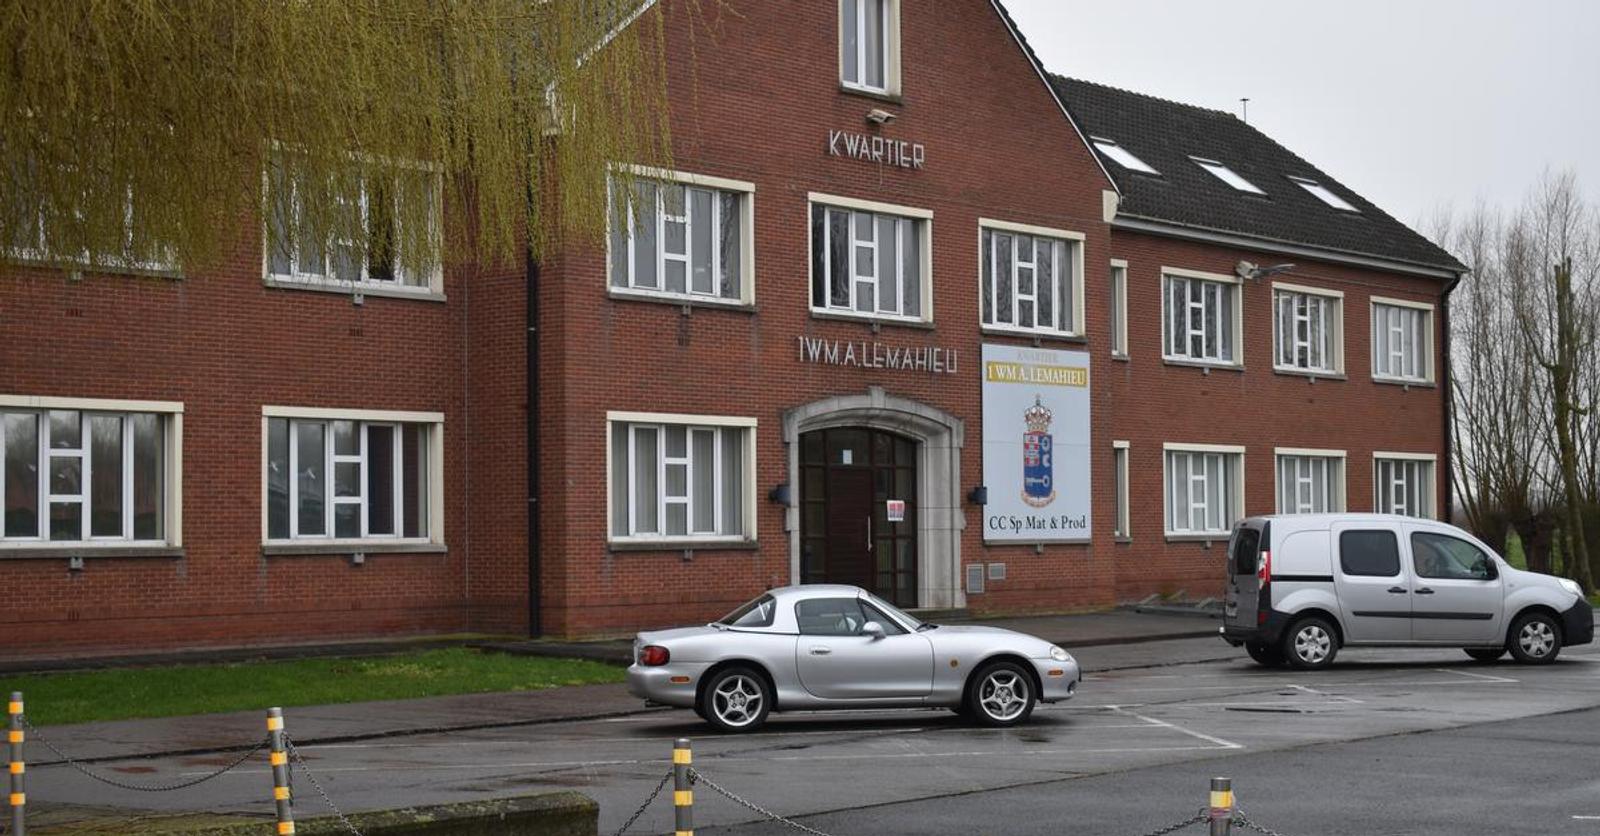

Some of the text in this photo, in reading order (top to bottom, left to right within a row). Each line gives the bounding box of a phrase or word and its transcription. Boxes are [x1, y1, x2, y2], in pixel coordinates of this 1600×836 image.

[829, 129, 925, 169] KWARTIER
[1030, 367, 1085, 385] LEMAHIEU
[989, 514, 1086, 534] CC Sp Mat & Prod
